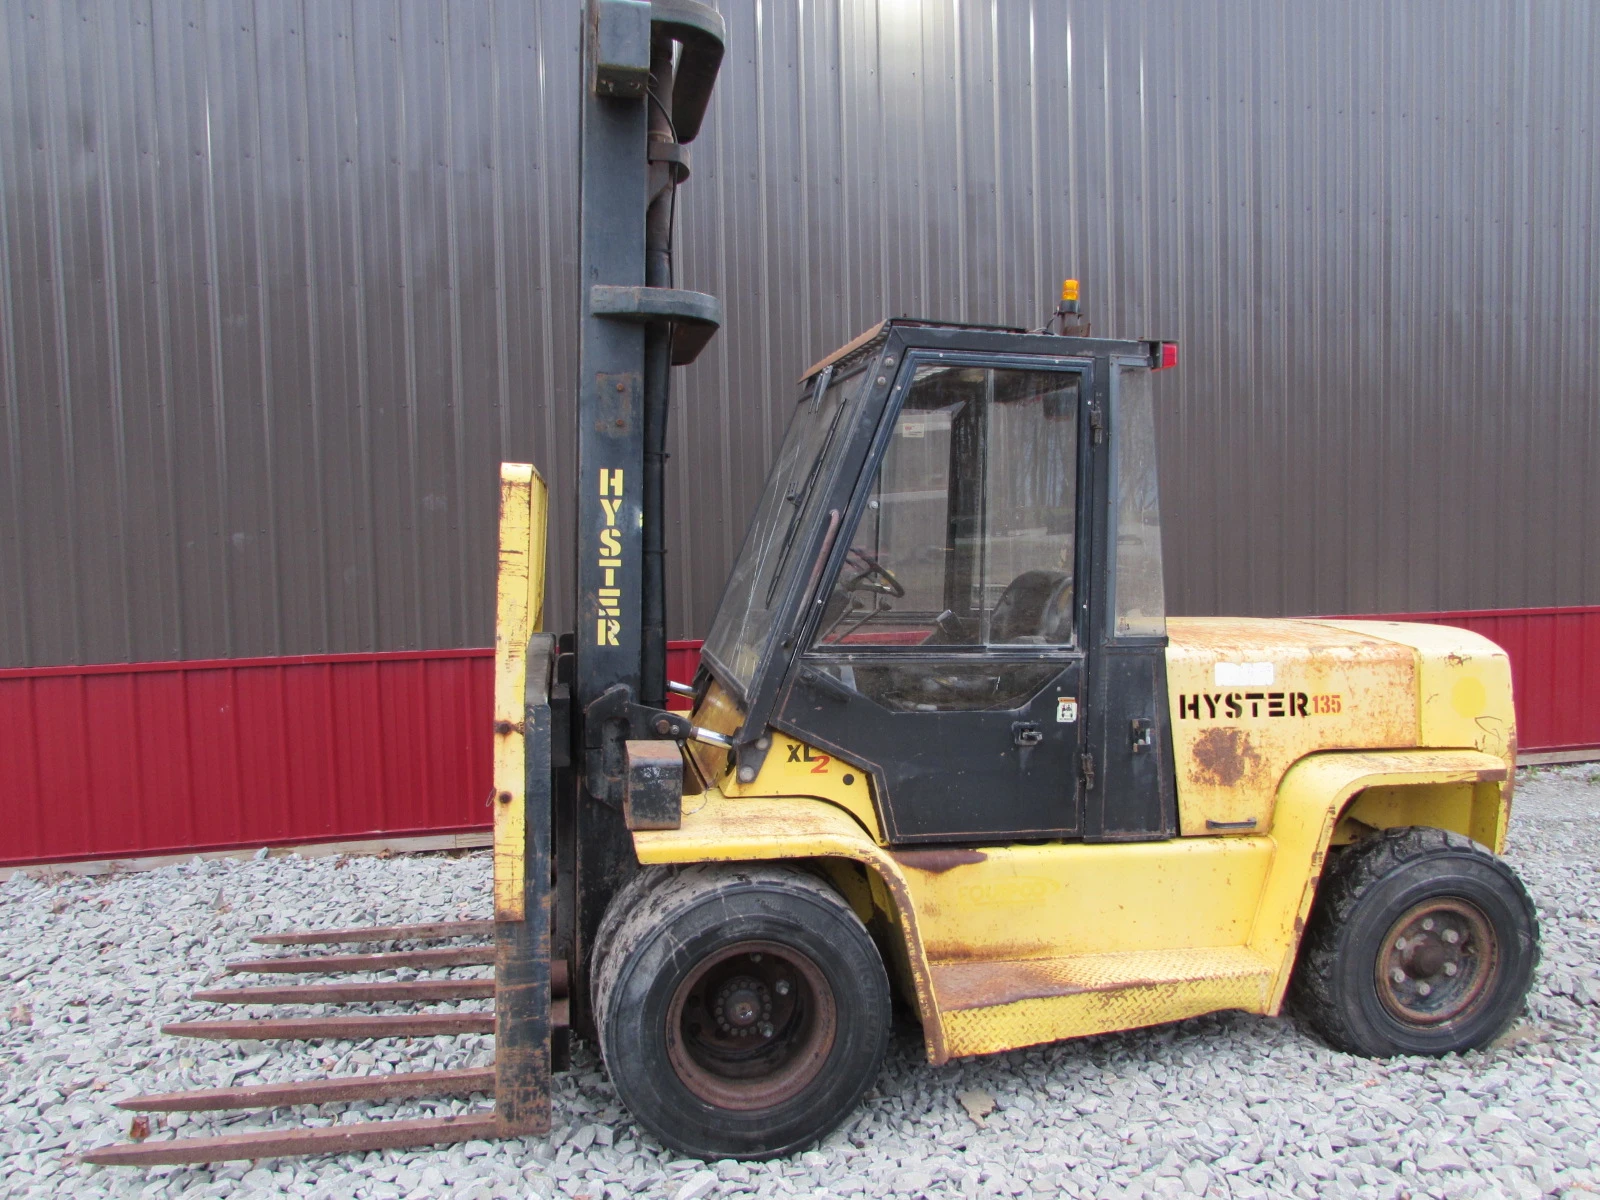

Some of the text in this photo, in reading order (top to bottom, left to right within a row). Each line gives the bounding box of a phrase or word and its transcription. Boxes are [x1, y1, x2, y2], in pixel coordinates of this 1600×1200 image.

[597, 468, 624, 646] HYSTER
[1179, 692, 1342, 720] HYSTER 135
